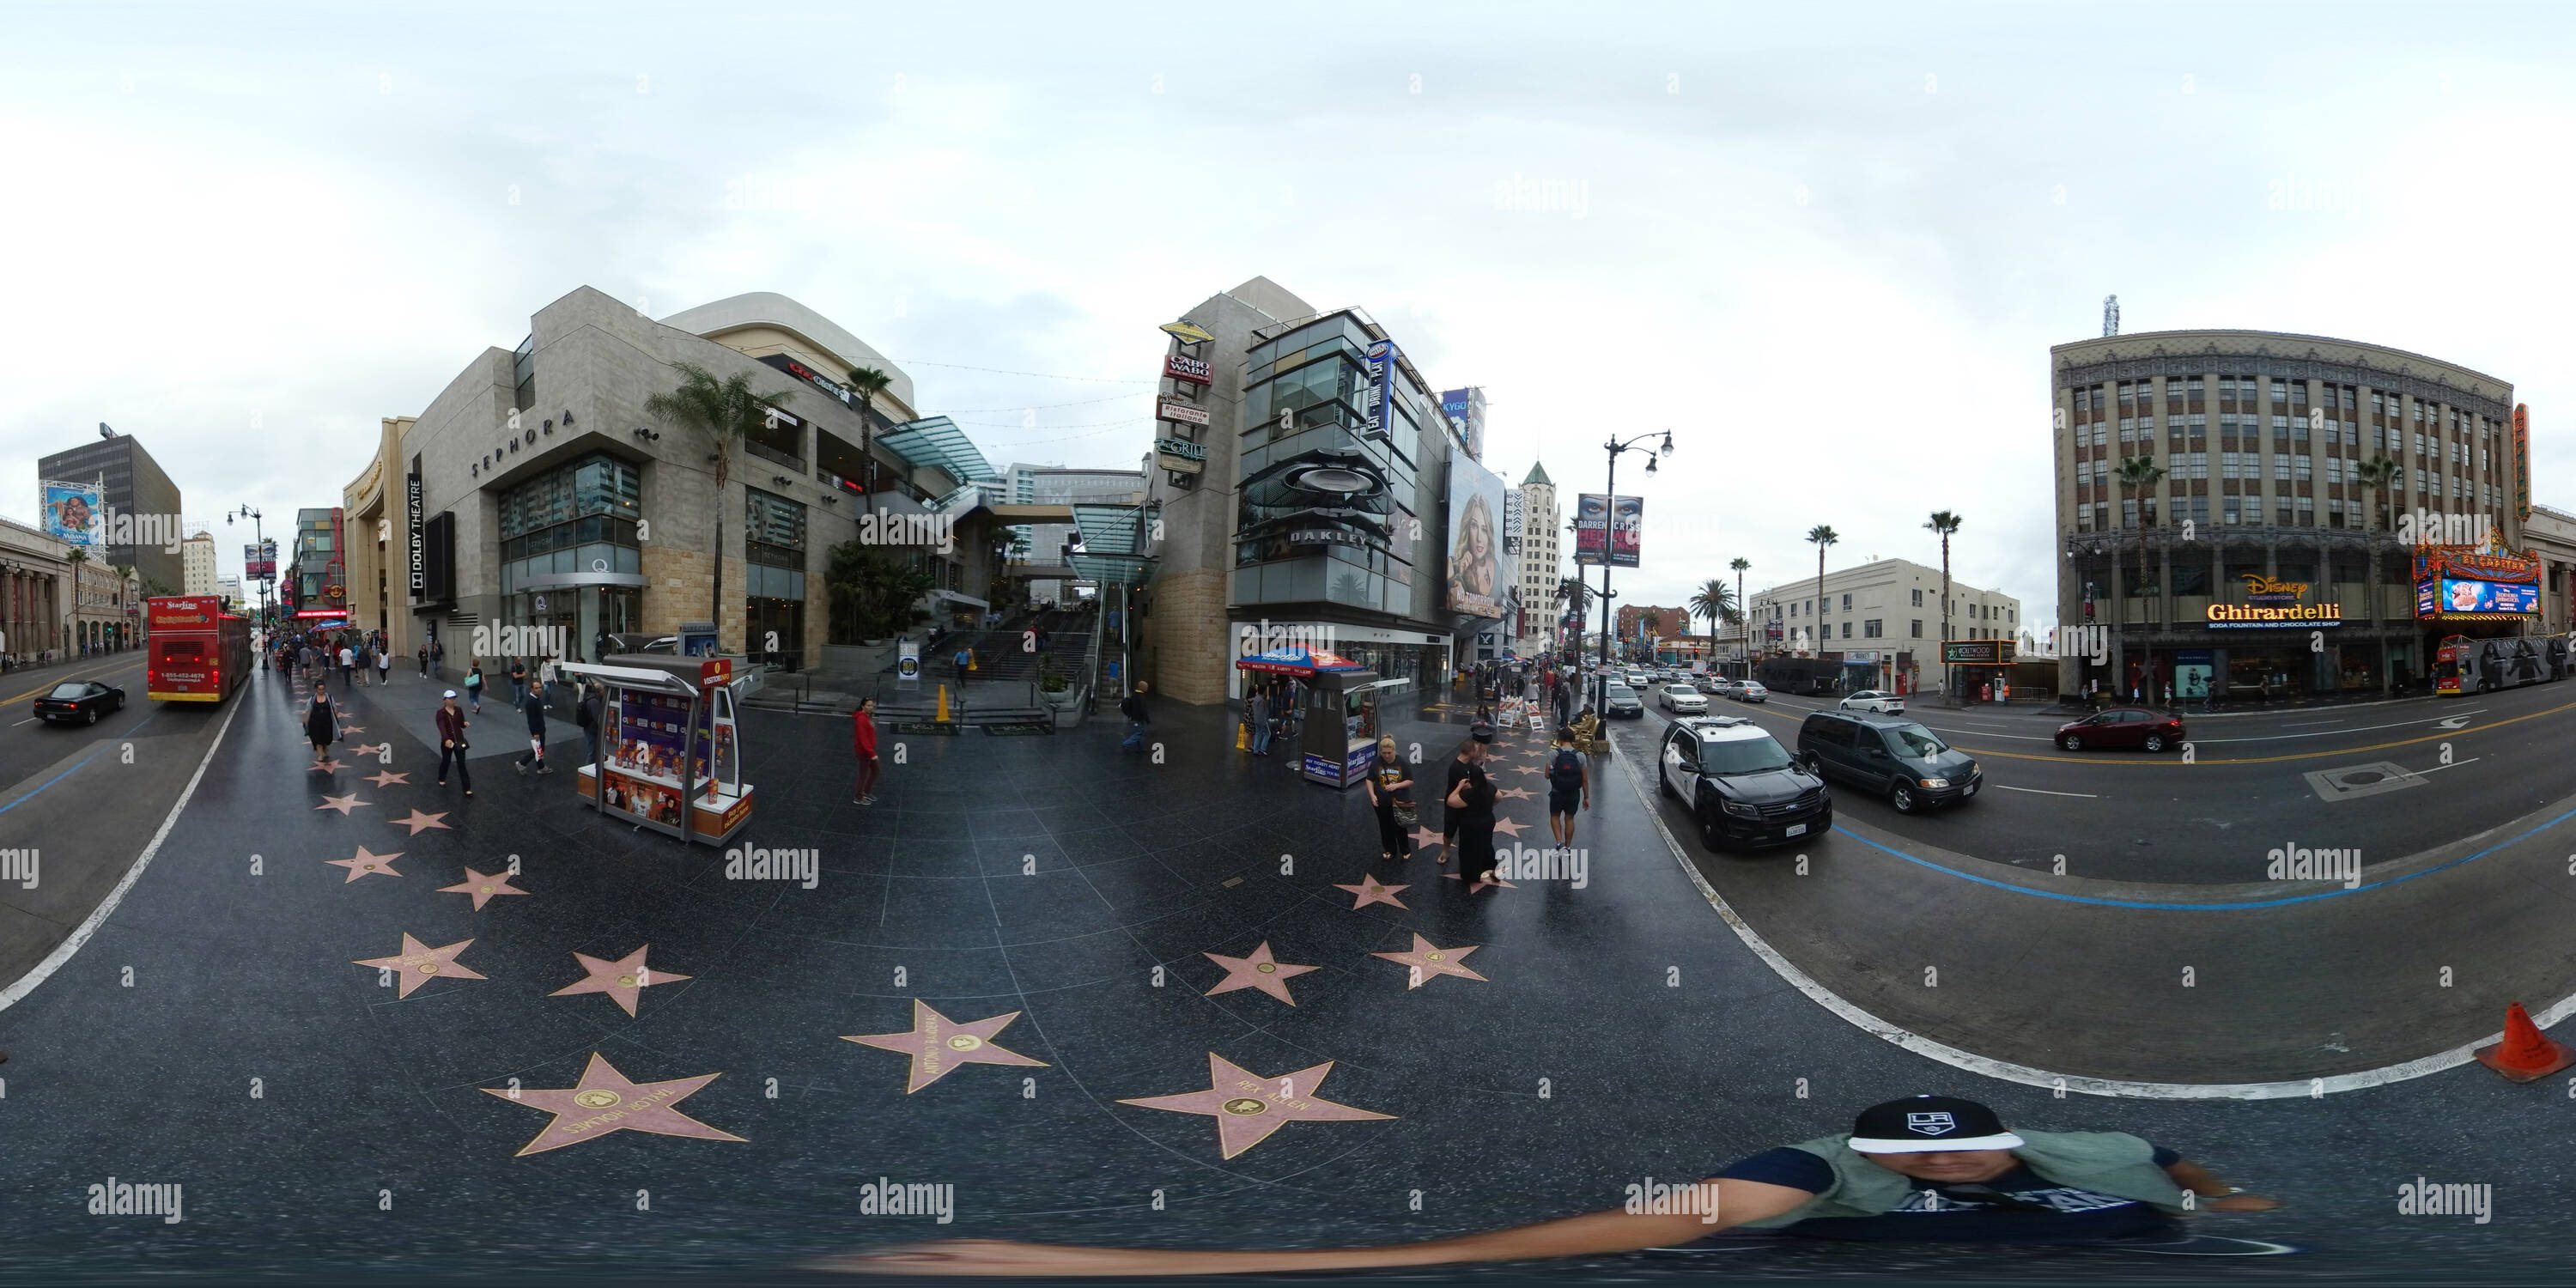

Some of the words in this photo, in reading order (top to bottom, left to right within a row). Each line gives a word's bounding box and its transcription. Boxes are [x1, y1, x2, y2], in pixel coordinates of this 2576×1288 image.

[1170, 356, 1210, 369] CABO
[1170, 362, 1210, 376] WABO
[1371, 361, 1383, 378] PLAY
[1370, 383, 1382, 407] DRINK
[1165, 405, 1207, 417] Ristorante
[1443, 402, 1467, 411] KYGO
[1170, 411, 1203, 422] Italiano
[1368, 416, 1380, 429] EAT
[472, 410, 574, 477] SEPHORA
[1170, 441, 1204, 456] GRILL
[410, 480, 420, 530] THEATRE
[1578, 520, 1607, 529] DARREN
[1614, 522, 1640, 532] CRISS
[1291, 531, 1366, 544] OAKLEY
[412, 532, 422, 570] DOLBY
[592, 558, 610, 573] Q
[2462, 554, 2476, 565] EL
[2478, 556, 2526, 571] CAPITAN
[167, 601, 197, 610] Starline
[535, 596, 547, 611] Q
[1456, 589, 1465, 601] NO
[1465, 592, 1495, 606] TOMORROW
[2207, 604, 2341, 621] Ghirardelli
[1305, 764, 1327, 775] Starline
[926, 1014, 939, 1044] BANDERAS
[924, 1046, 941, 1074] ANTONIO
[627, 1089, 675, 1111] TAYLOR
[1236, 1080, 1265, 1093] REX
[1264, 1092, 1311, 1110] ALLEN
[562, 1110, 629, 1133] HOLMES
